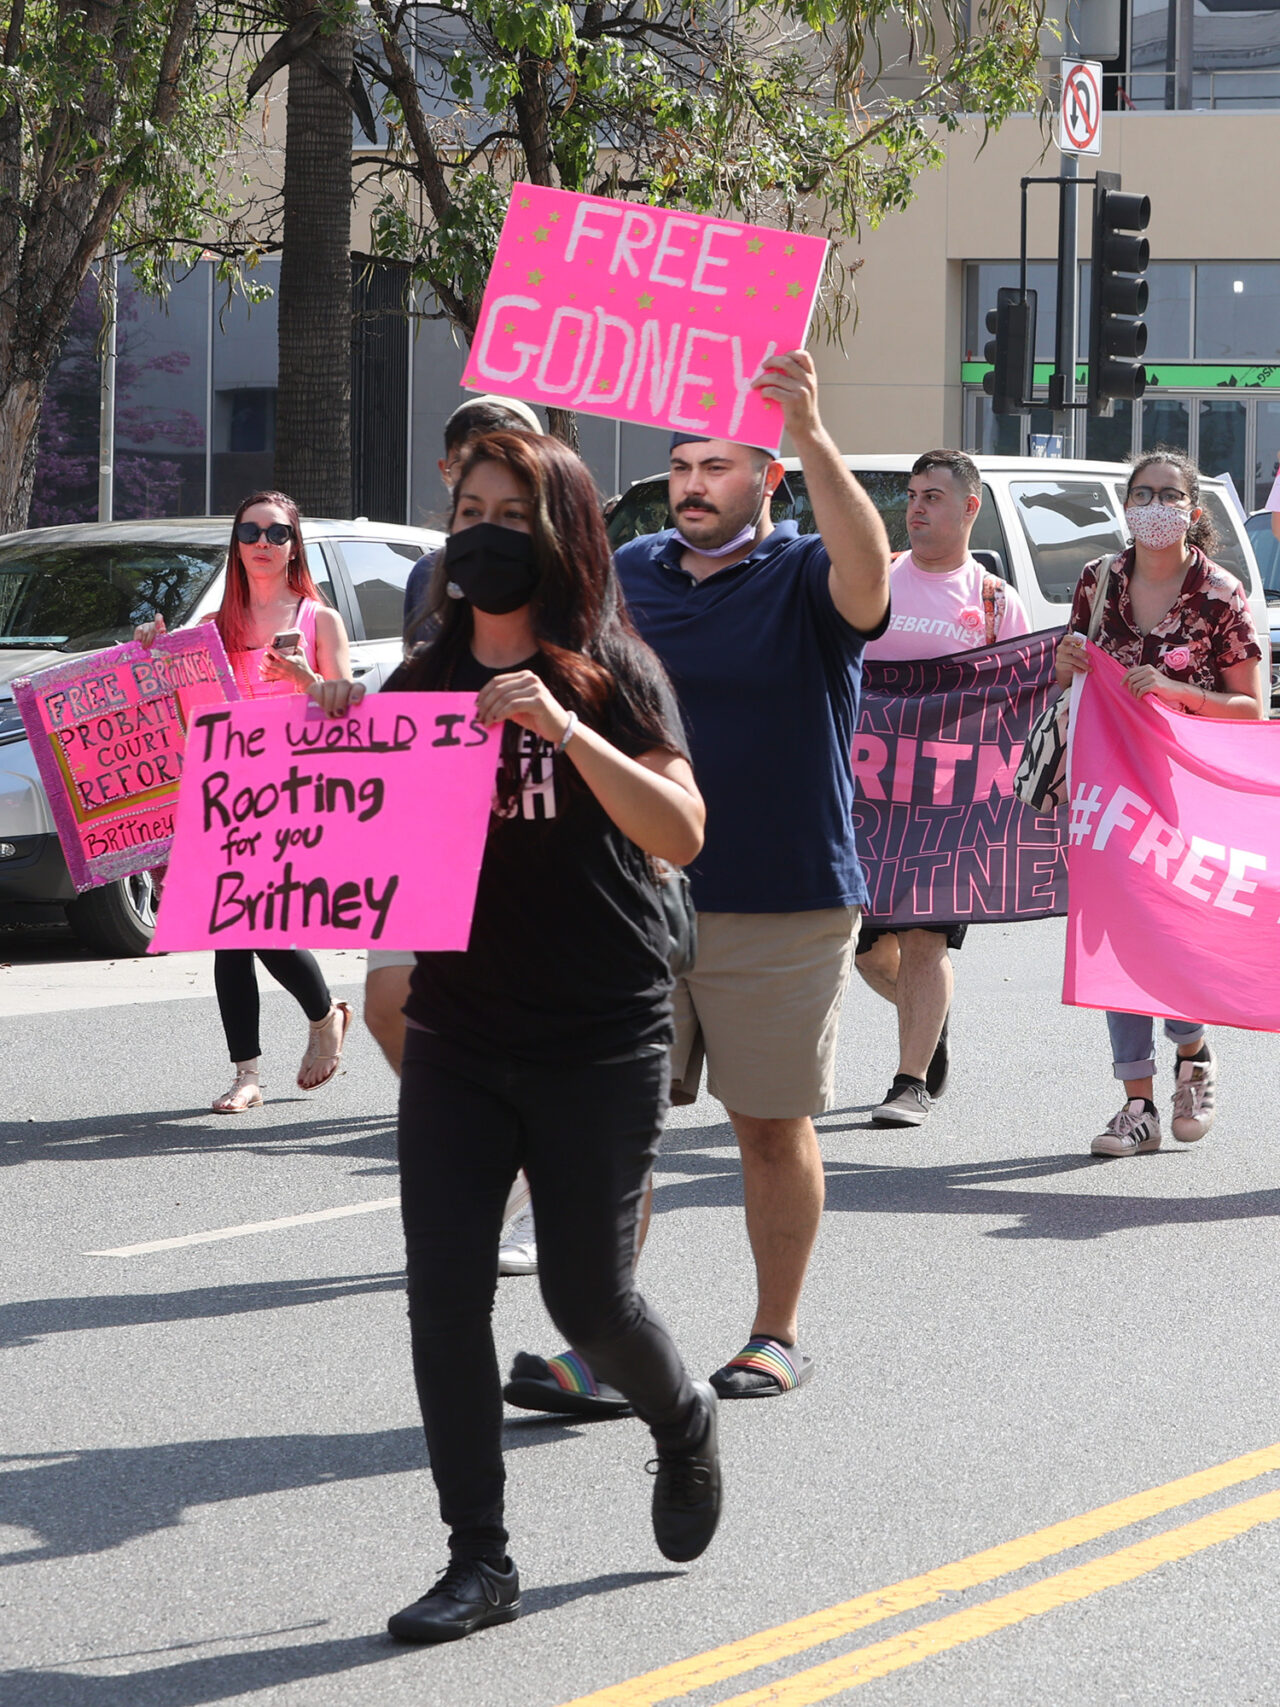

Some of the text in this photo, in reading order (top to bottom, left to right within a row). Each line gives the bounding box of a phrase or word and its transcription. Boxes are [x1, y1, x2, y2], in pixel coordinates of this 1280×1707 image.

[564, 201, 743, 295] FREE
[477, 295, 777, 437] GODNEY
[45, 673, 127, 727] FREE
[58, 695, 178, 749] PROBATE
[98, 726, 170, 767] COURT
[195, 711, 265, 763] The
[431, 713, 489, 747] IS
[202, 766, 384, 832] Rooting
[221, 825, 323, 865] for you
[1069, 783, 1267, 917] #FREE
[209, 862, 399, 940] Britney
